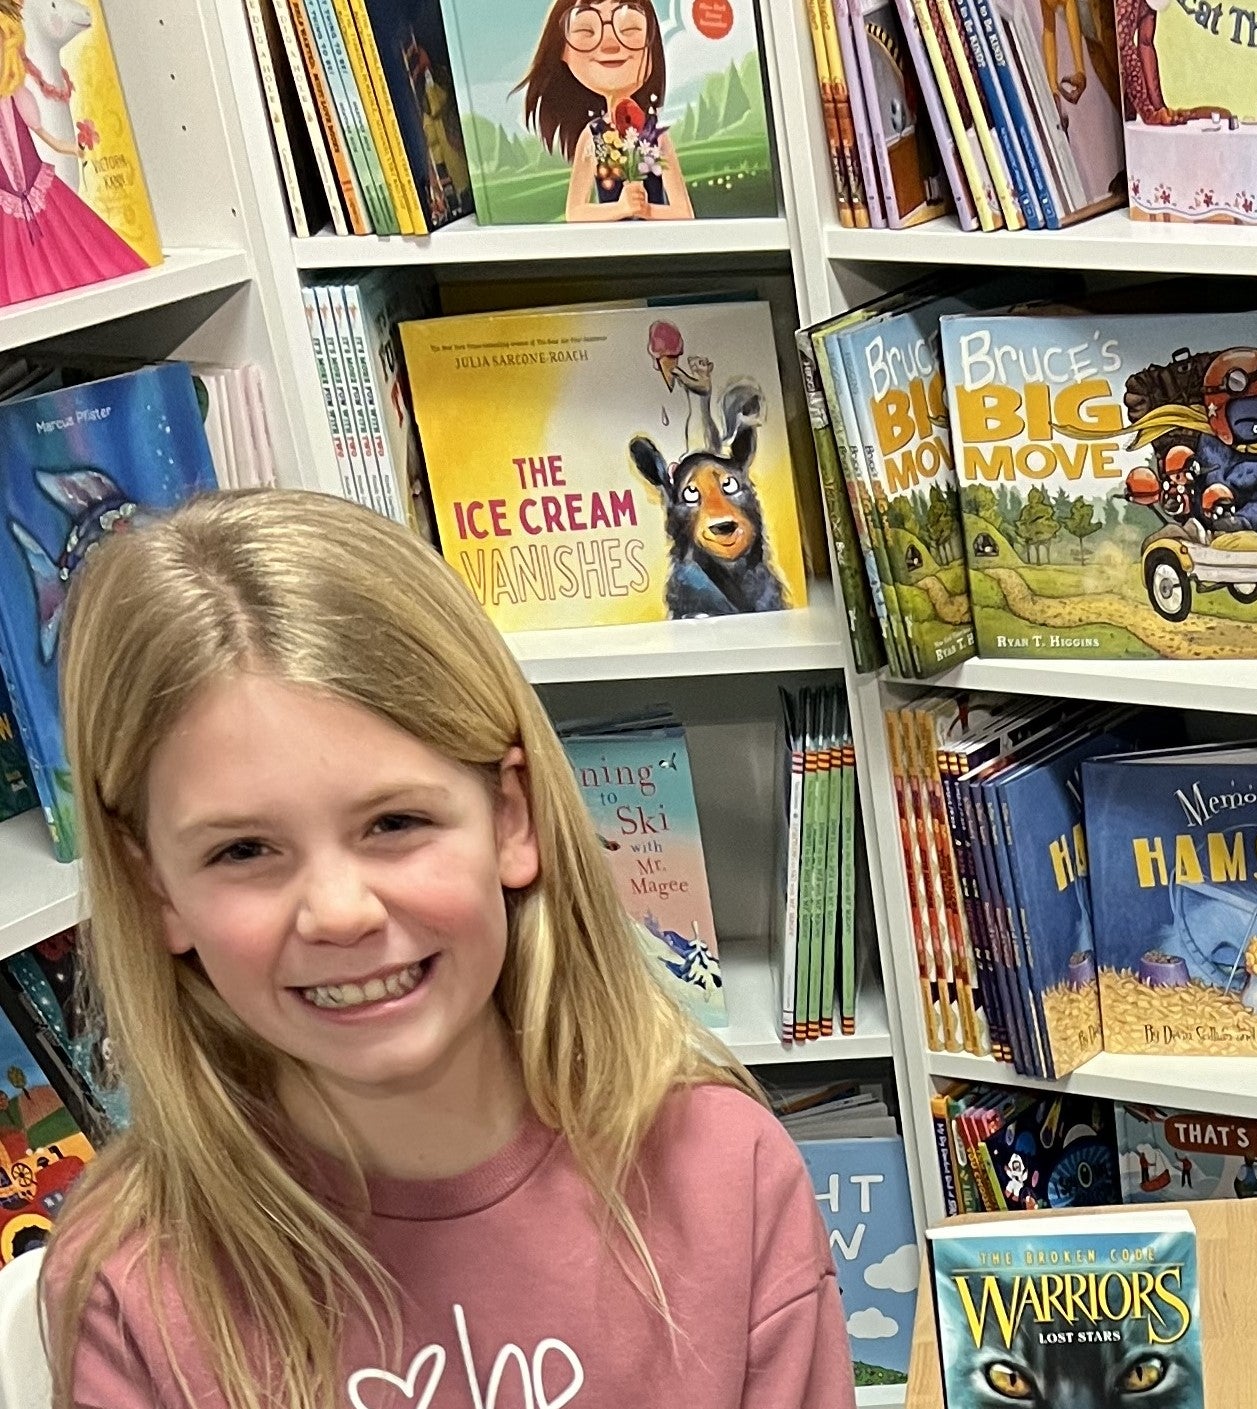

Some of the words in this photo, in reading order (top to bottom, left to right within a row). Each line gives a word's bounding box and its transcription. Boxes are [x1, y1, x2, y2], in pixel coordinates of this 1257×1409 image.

[455, 356, 490, 369] JULIA
[955, 377, 1123, 443] BIG
[35, 414, 74, 434] Marcus
[512, 455, 567, 490] THE
[963, 442, 1122, 481] MOVE
[453, 499, 512, 540] ICE
[518, 489, 638, 536] CREAM
[459, 538, 650, 606] VANISHES
[1032, 635, 1046, 648] T.
[1050, 635, 1100, 648] HIGGINS
[600, 792, 618, 806] to
[616, 804, 670, 836] Ski
[630, 839, 663, 853] with
[636, 859, 667, 876] Mr.
[630, 877, 690, 900] Magee
[1174, 1122, 1250, 1148] THAT'S
[979, 1252, 1013, 1265] THE
[1026, 1249, 1097, 1264] BROKEN
[1110, 1248, 1157, 1263] CODE
[951, 1266, 1192, 1349] WARRIORS
[1039, 1331, 1075, 1344] LOST
[1077, 1330, 1121, 1344] STARS
